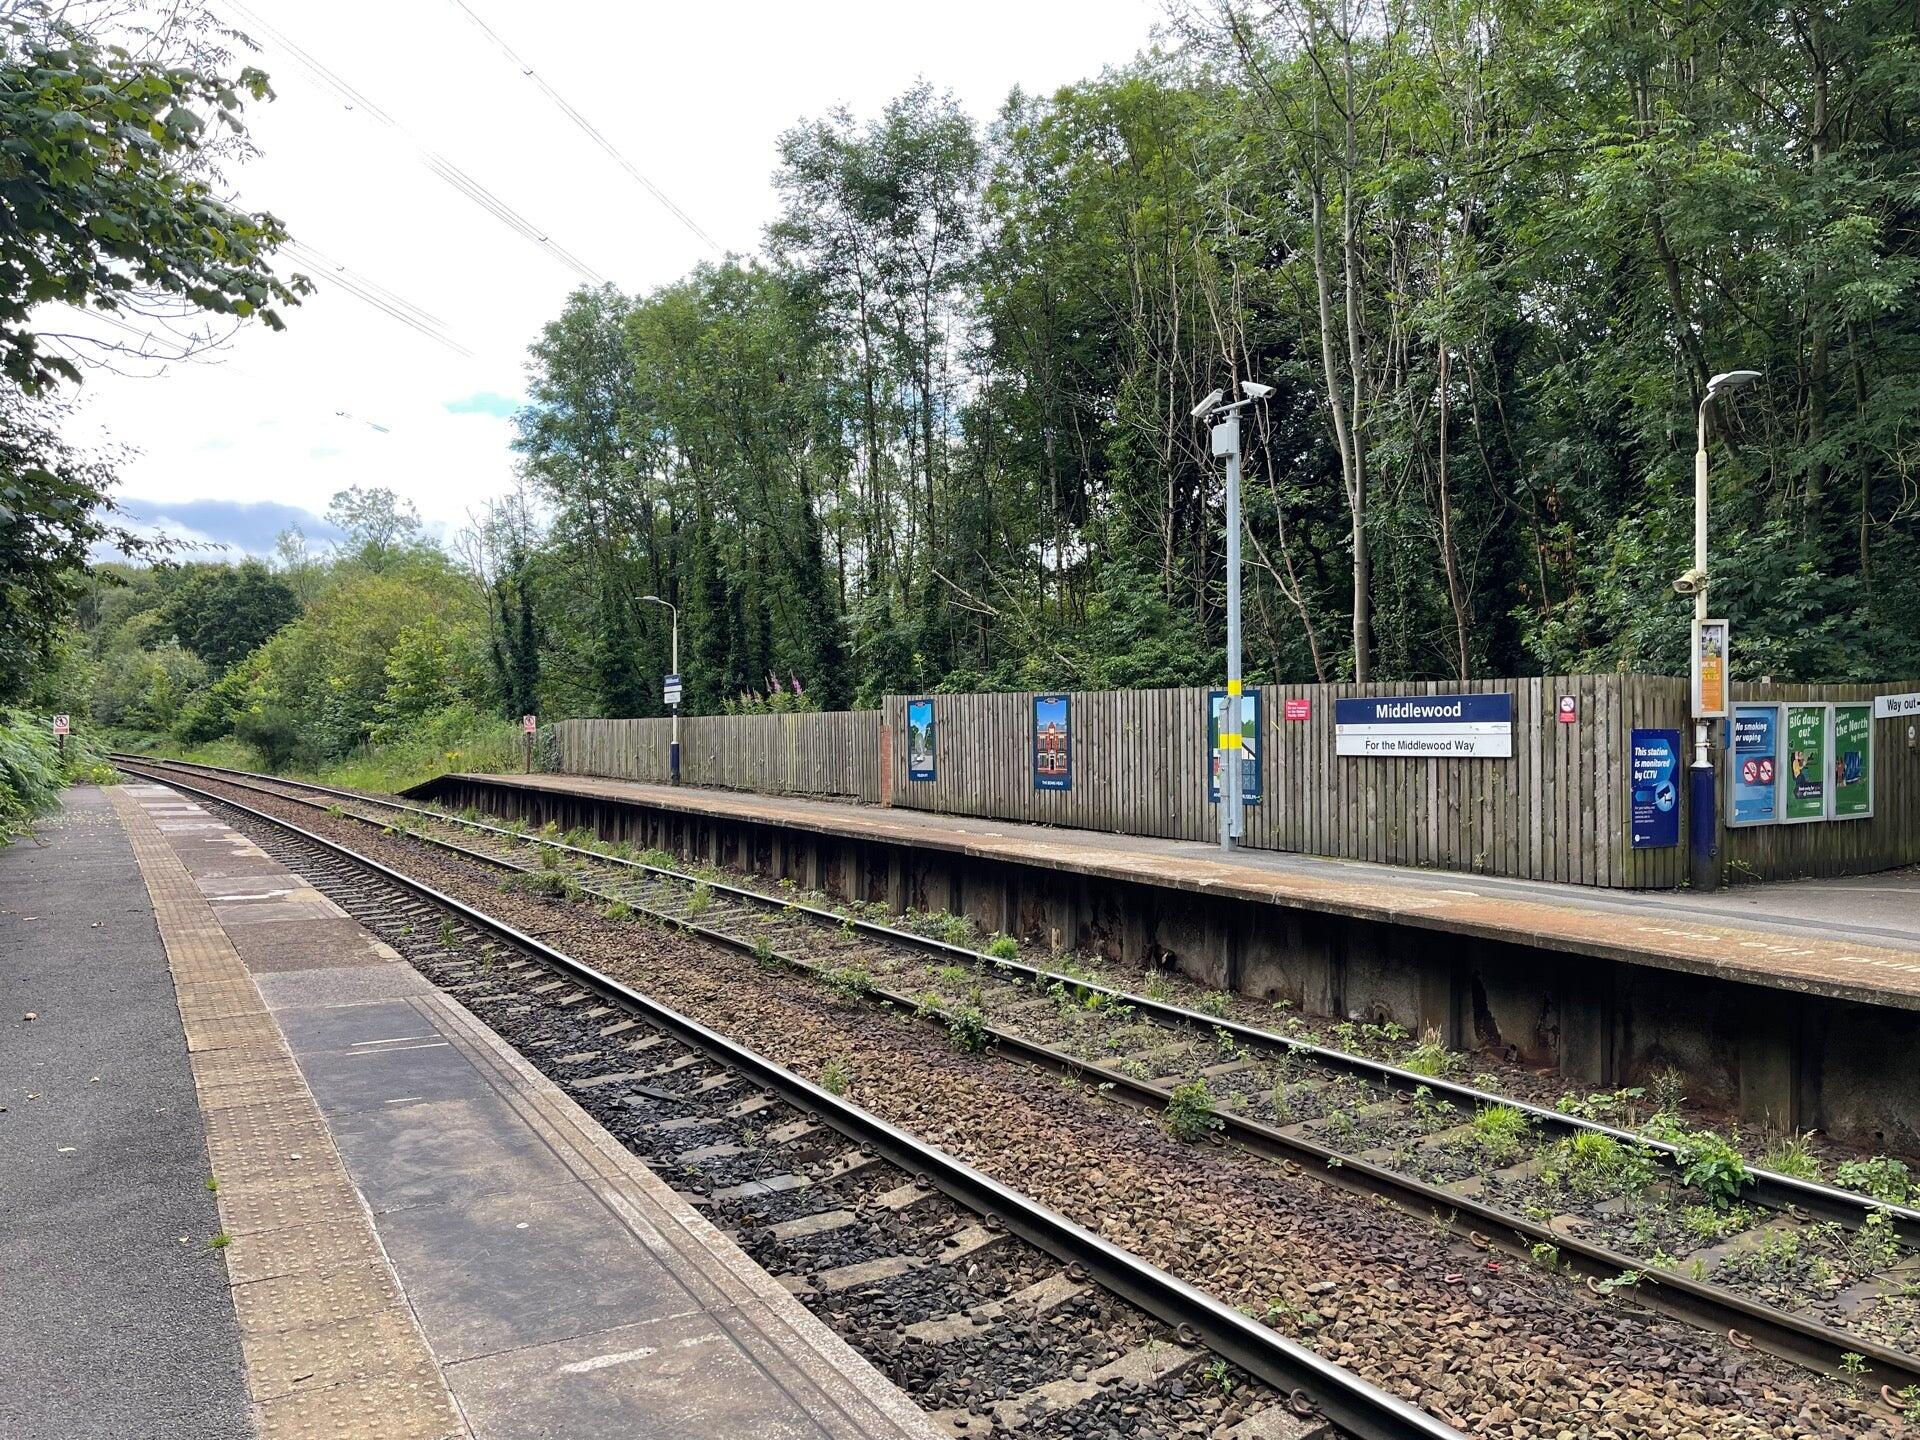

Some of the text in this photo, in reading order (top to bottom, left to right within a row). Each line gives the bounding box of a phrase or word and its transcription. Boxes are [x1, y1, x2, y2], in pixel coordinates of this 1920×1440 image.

[1376, 701, 1462, 718] Middlewood
[1887, 698, 1916, 712] Way out
[1790, 713, 1820, 728] BIG days
[1736, 722, 1767, 732] No smoking
[1799, 727, 1811, 738] out
[1836, 718, 1868, 737] the North
[1736, 733, 1761, 743] or vaping
[1365, 740, 1475, 752] For the Middlewood Way
[1635, 747, 1668, 756] This station
[1634, 758, 1670, 767] is monitored
[1634, 770, 1657, 781] by CCTV
